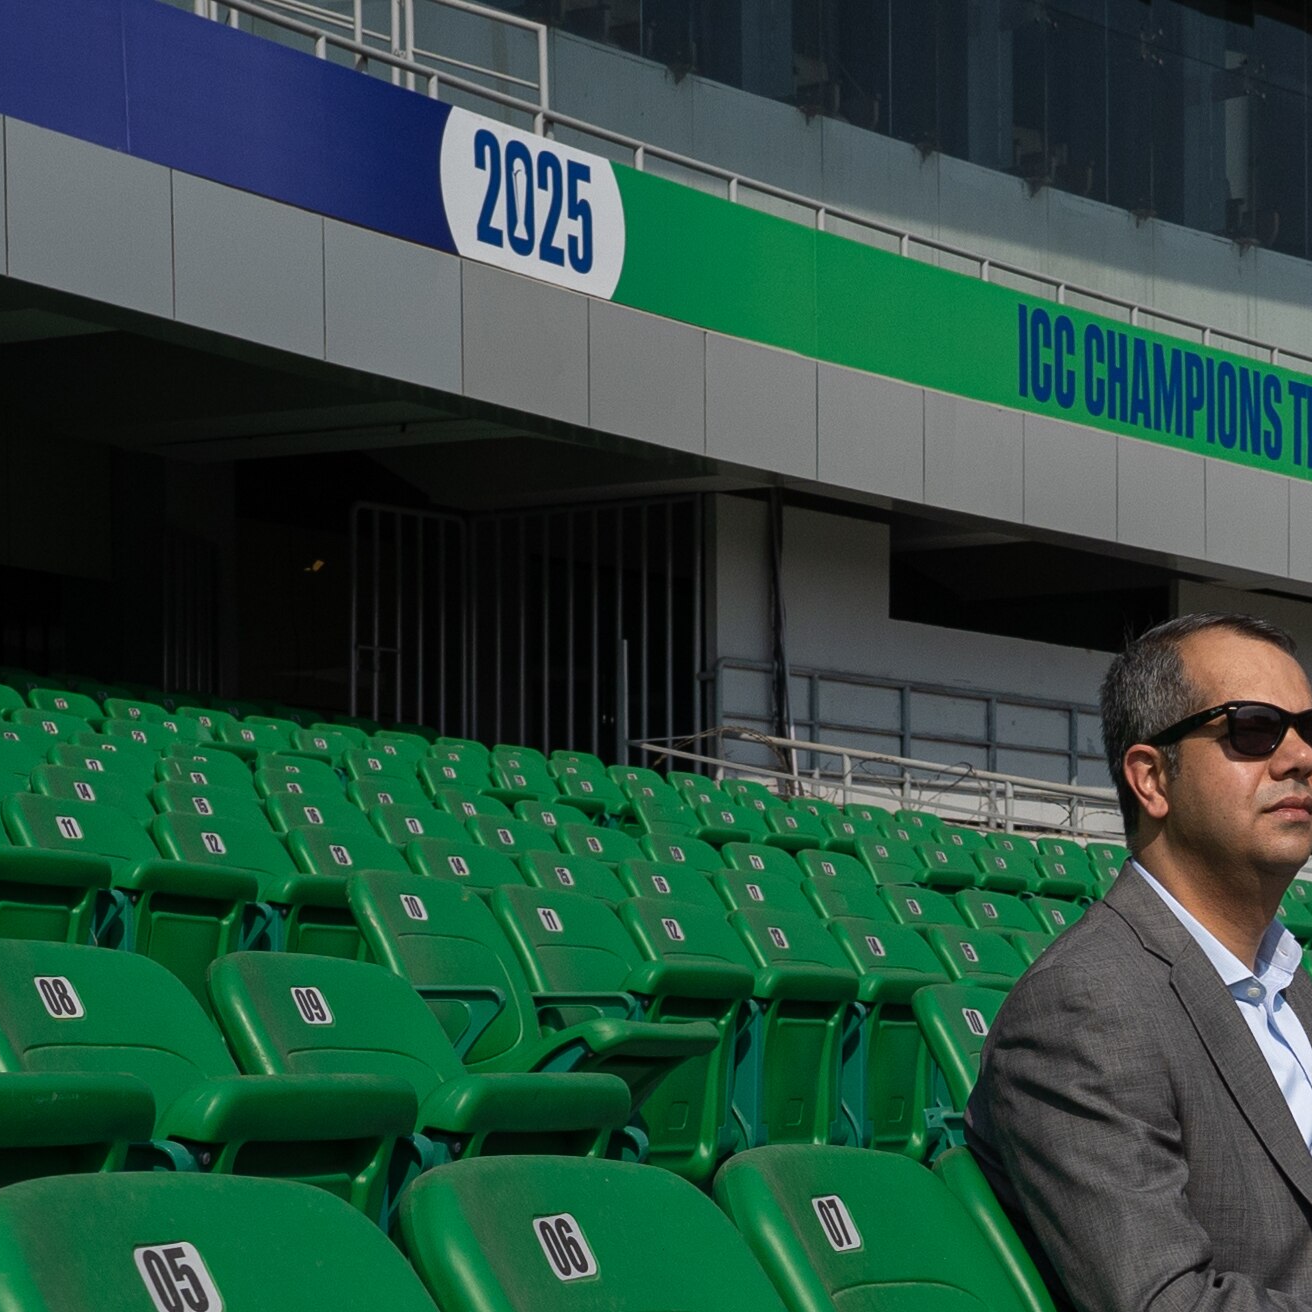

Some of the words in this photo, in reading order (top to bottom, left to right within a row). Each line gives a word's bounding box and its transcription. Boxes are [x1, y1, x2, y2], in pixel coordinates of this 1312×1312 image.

[474, 128, 594, 274] 2025
[1018, 303, 1075, 409] ICC
[1084, 322, 1283, 461] CHAMPIONS
[77, 784, 91, 799] 14
[61, 818, 78, 838] 11
[409, 819, 419, 833] 17
[205, 835, 222, 853] 12
[333, 847, 348, 864] 13
[451, 858, 465, 874] 14
[404, 897, 422, 918] 10
[542, 910, 558, 930] 11
[665, 920, 681, 939] 12
[771, 929, 785, 947] 13
[868, 938, 881, 954] 14
[39, 979, 77, 1015] 08
[295, 989, 326, 1022] 09
[965, 1010, 984, 1034] 10
[817, 1199, 852, 1247] 07
[539, 1218, 588, 1276] 06
